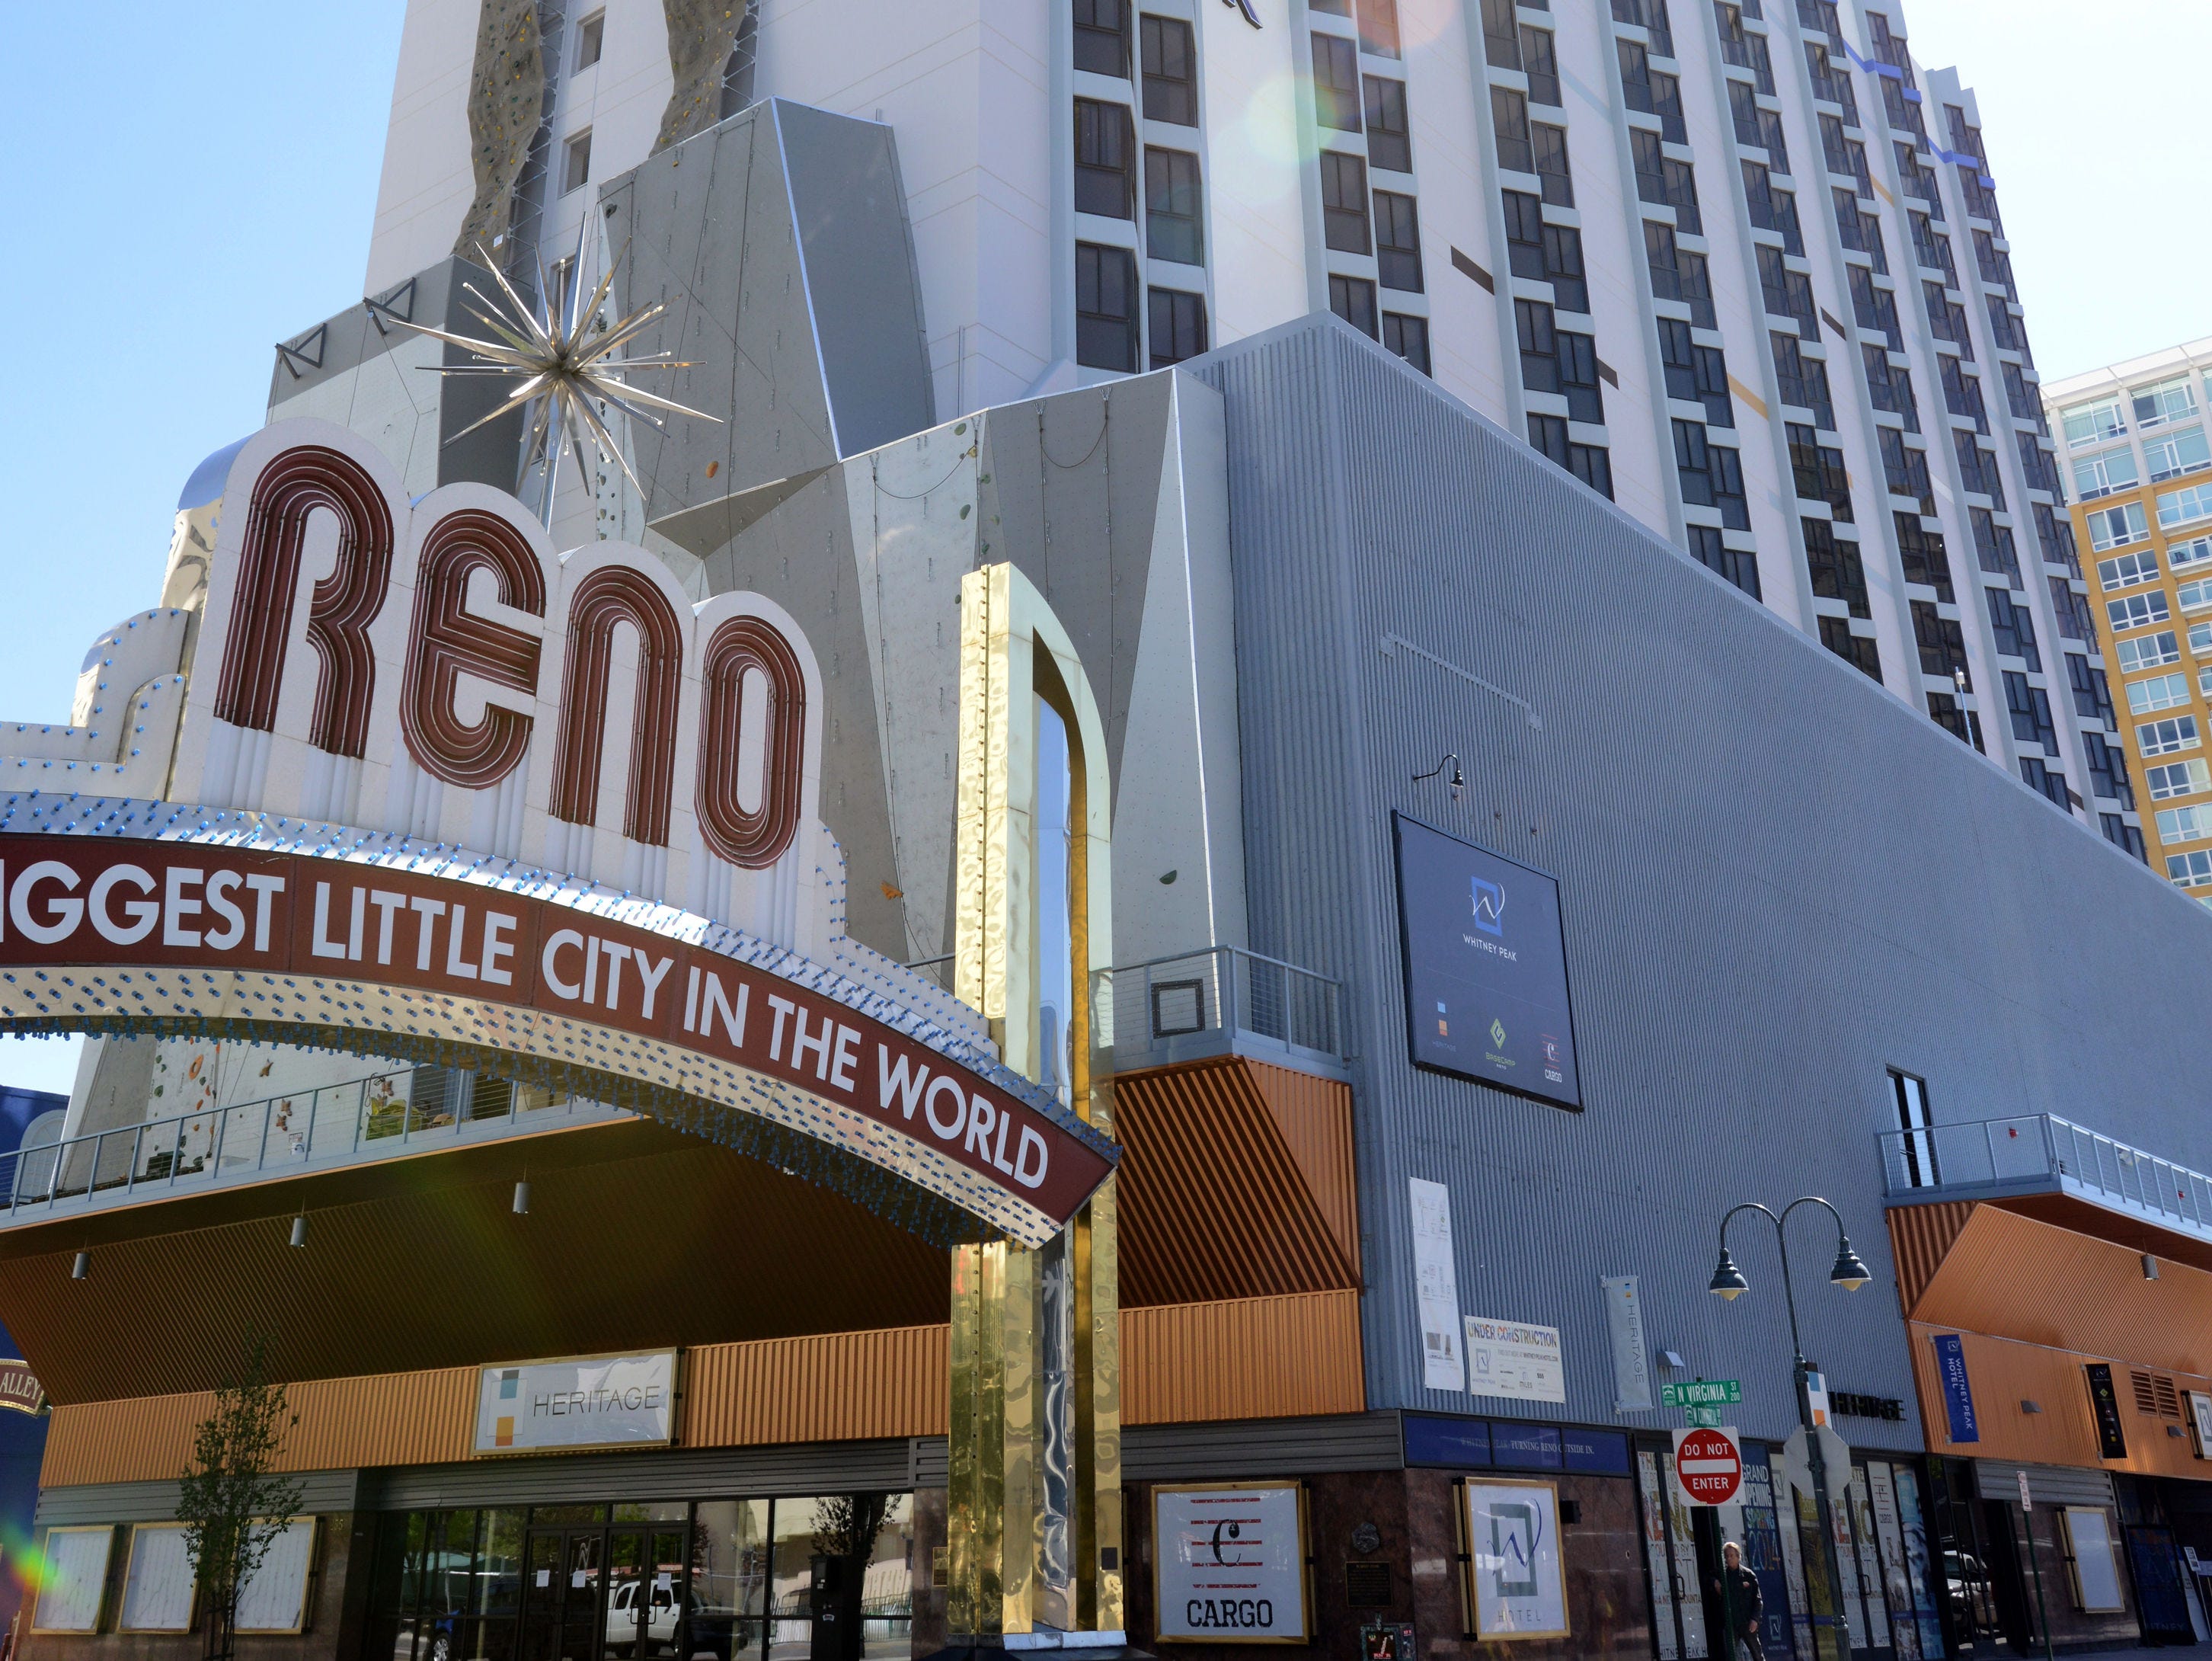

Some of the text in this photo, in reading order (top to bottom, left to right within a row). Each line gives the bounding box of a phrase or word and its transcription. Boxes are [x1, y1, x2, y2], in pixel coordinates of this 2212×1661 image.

[1462, 933, 1517, 962] WHITNEY PEAK
[0, 859, 1048, 1189] GGEST LITTLE CITY IN THE WORLD
[1545, 1069, 1562, 1083] CARGO
[1467, 1321, 1558, 1348] UNDER CONSTRUCTION
[1627, 1304, 1645, 1384] HERITAGE
[1948, 1357, 1958, 1389] HOTEL
[533, 1385, 660, 1417] HERITAGE
[1677, 1381, 1737, 1402] N VIRGINIA ST
[1730, 1392, 1741, 1401] 200
[1955, 1357, 1974, 1430] WHITNEY PEAK
[1510, 1439, 1540, 1451] TURNING
[1540, 1442, 1558, 1453] RENO
[1684, 1443, 1728, 1456] DO NOT
[1693, 1477, 1729, 1490] ENTER
[1742, 1465, 1769, 1482] GRAND
[1749, 1530, 1781, 1572] 2014
[1187, 1599, 1273, 1627] CARGO
[1498, 1609, 1541, 1622] HOTEL
